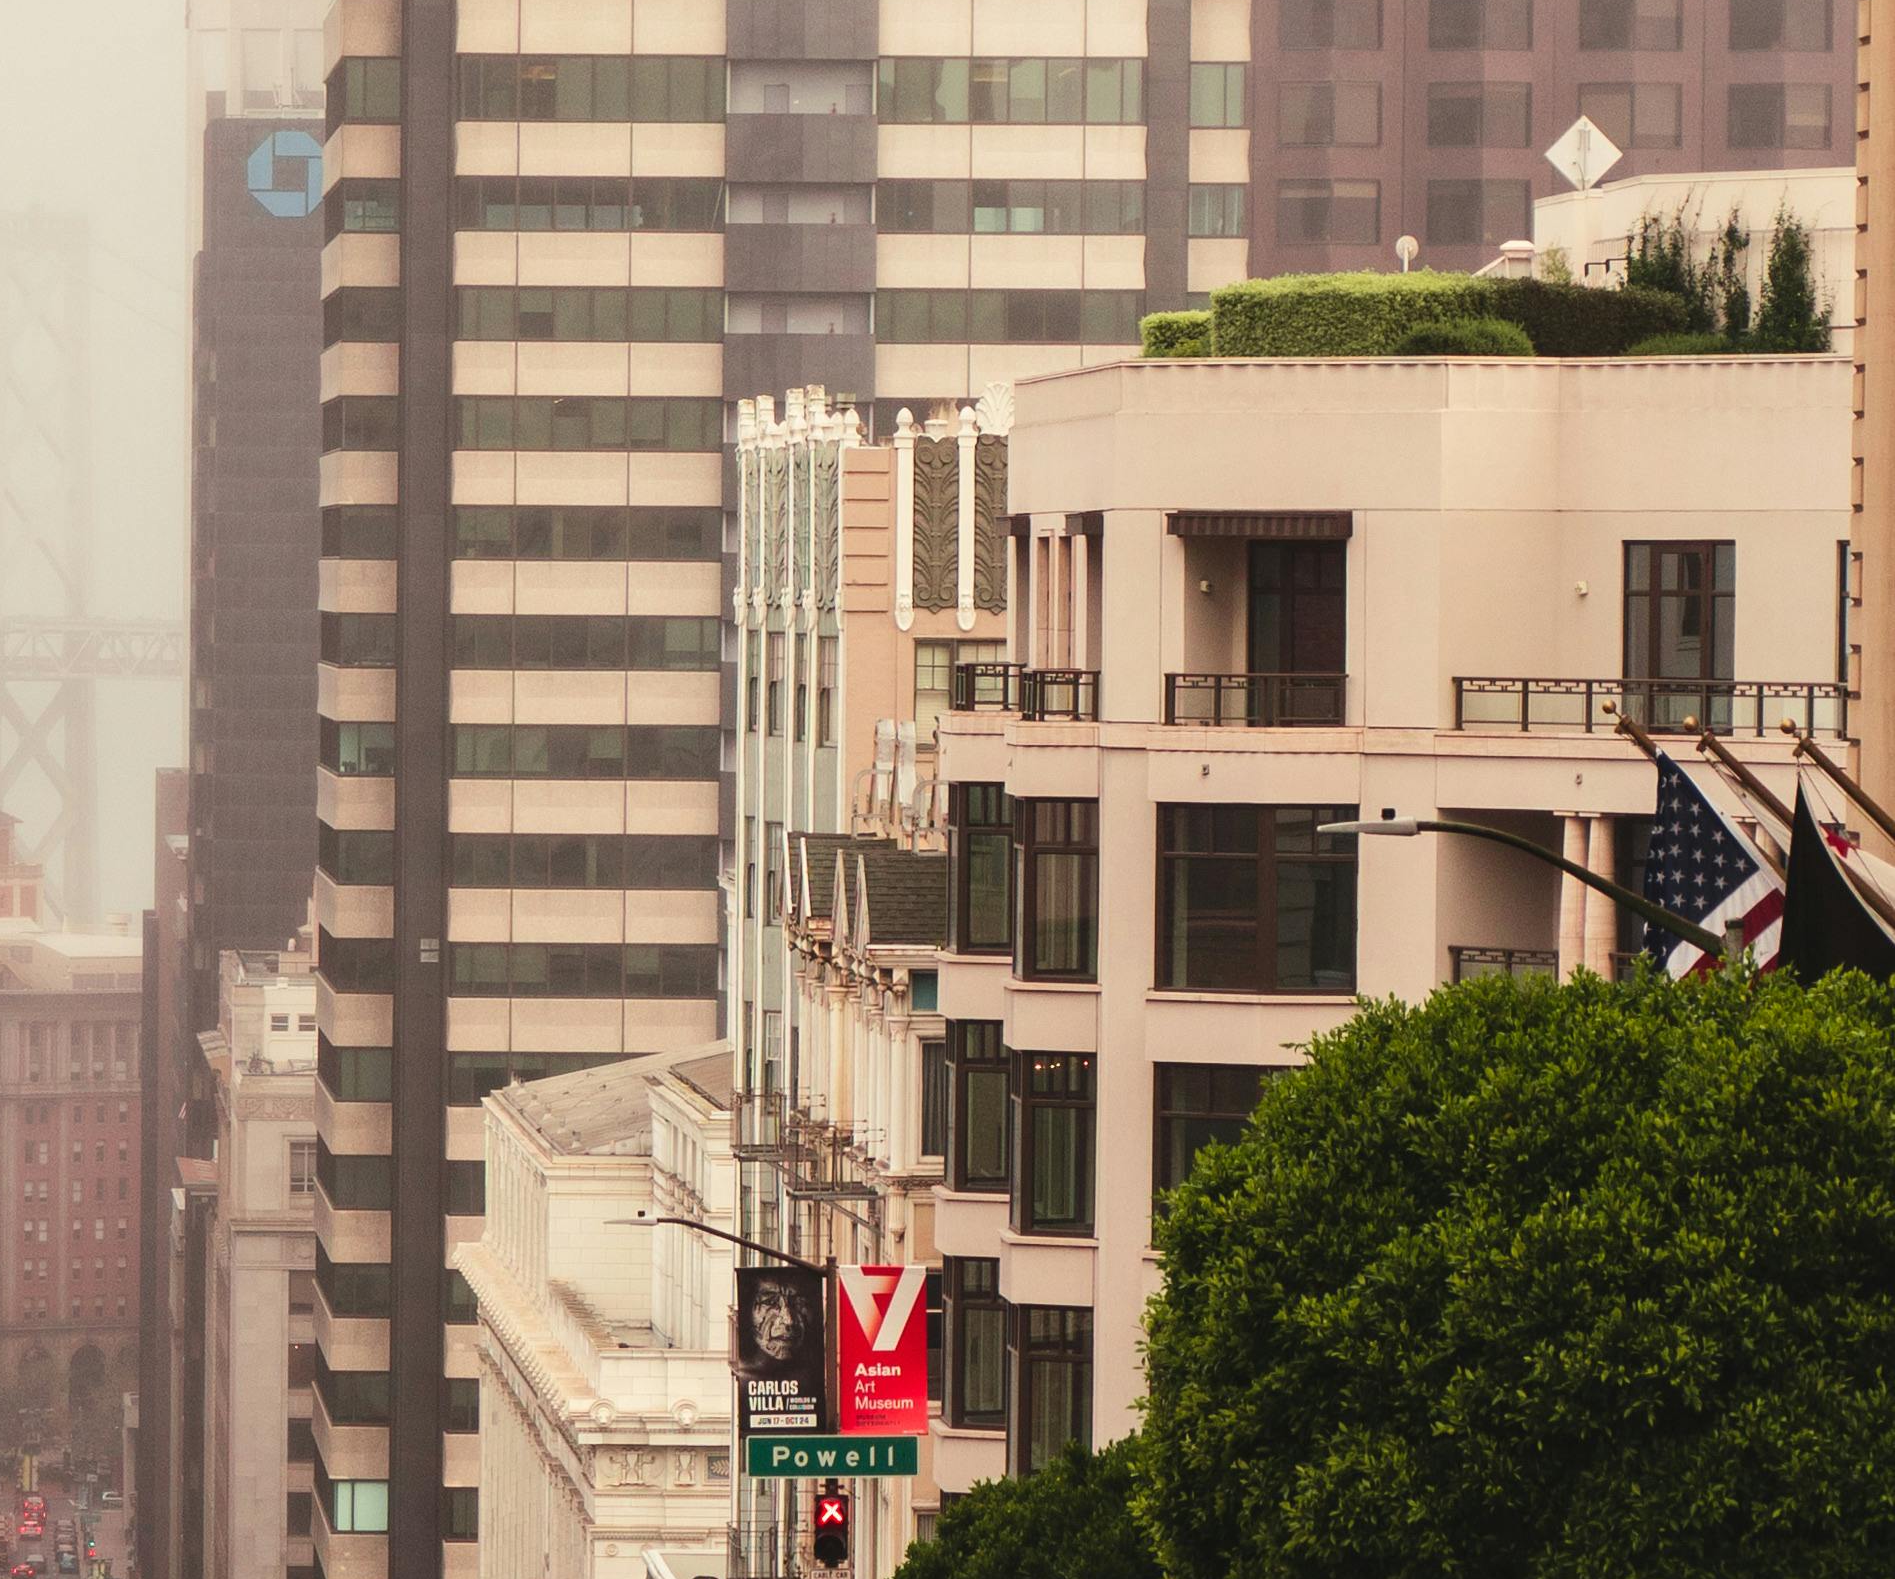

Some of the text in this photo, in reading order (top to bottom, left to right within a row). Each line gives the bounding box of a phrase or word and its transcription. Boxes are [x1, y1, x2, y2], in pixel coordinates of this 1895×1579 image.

[855, 1362, 901, 1377] Asian
[748, 1380, 798, 1395] CARLOS
[854, 1380, 875, 1393] Art
[749, 1396, 784, 1411] VILLA
[855, 1396, 914, 1410] Museum
[772, 1445, 894, 1467] Powell
